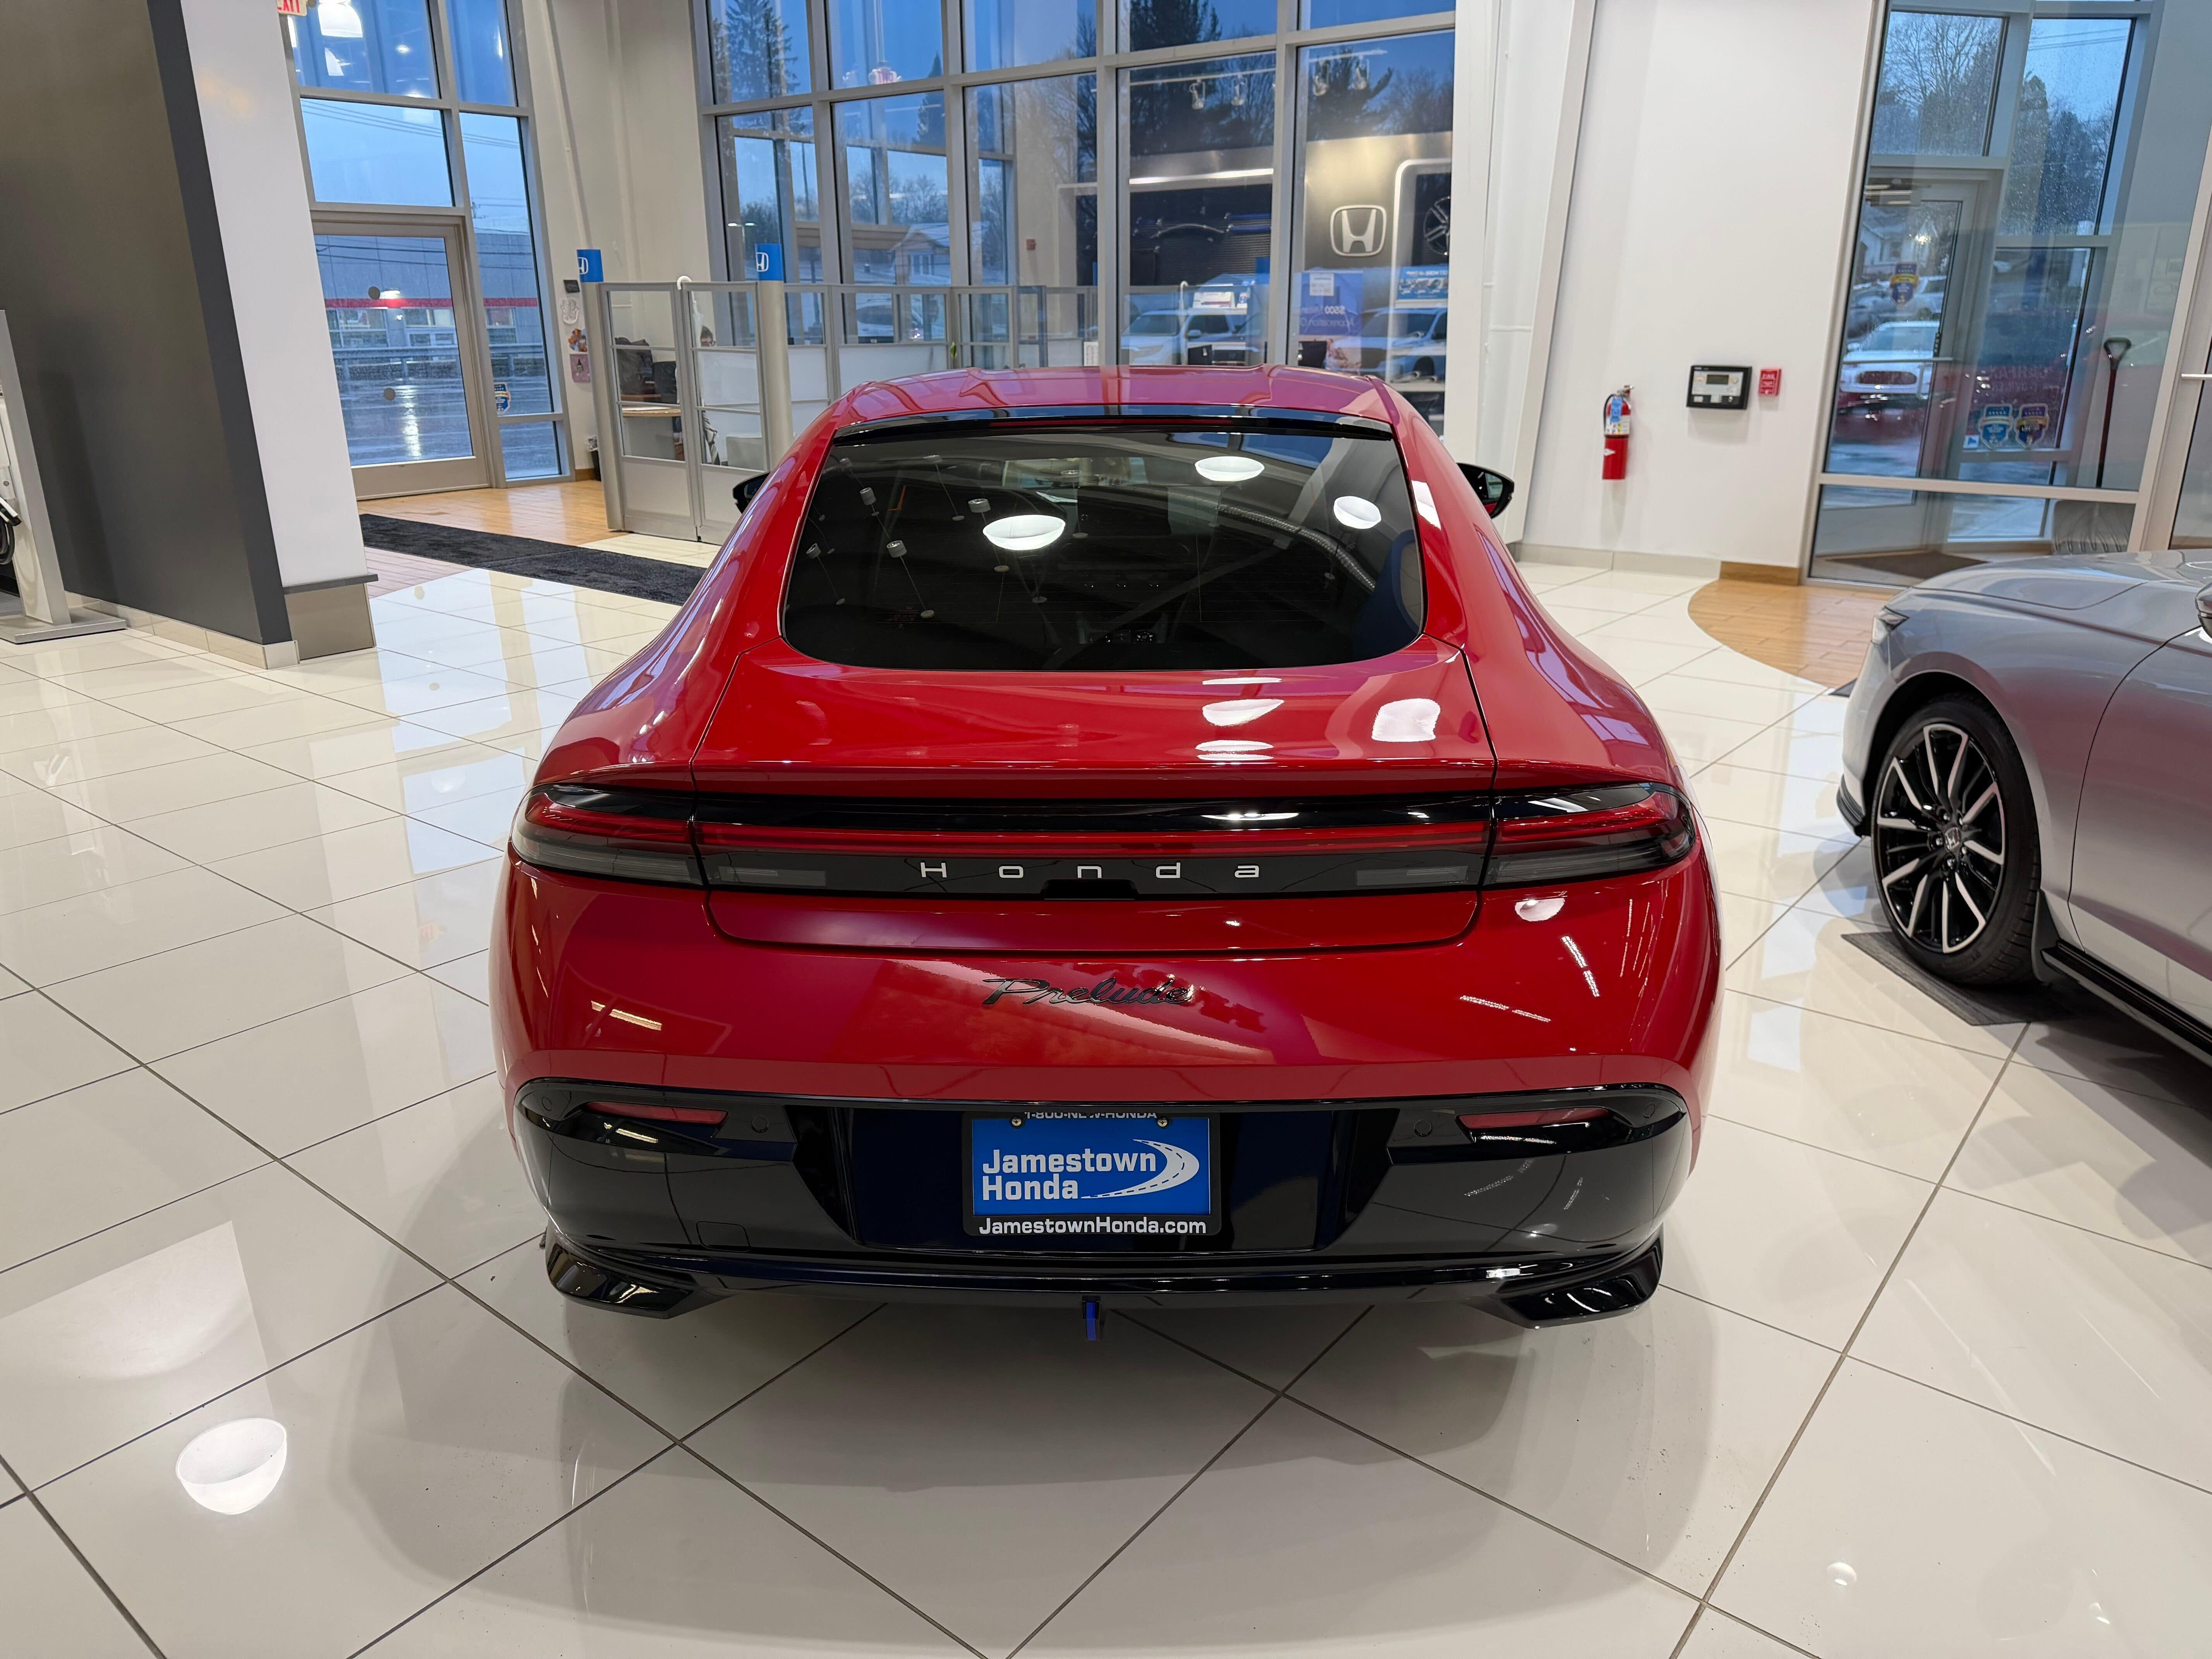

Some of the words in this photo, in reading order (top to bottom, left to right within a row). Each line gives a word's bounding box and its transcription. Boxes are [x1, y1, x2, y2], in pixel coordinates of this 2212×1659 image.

[920, 862, 1260, 878] Honda
[982, 974, 1194, 1005] Prelude
[982, 1148, 1156, 1174] Jamestown
[982, 1174, 1079, 1200] Honda
[979, 1216, 1207, 1234] JamestownHonda.com
